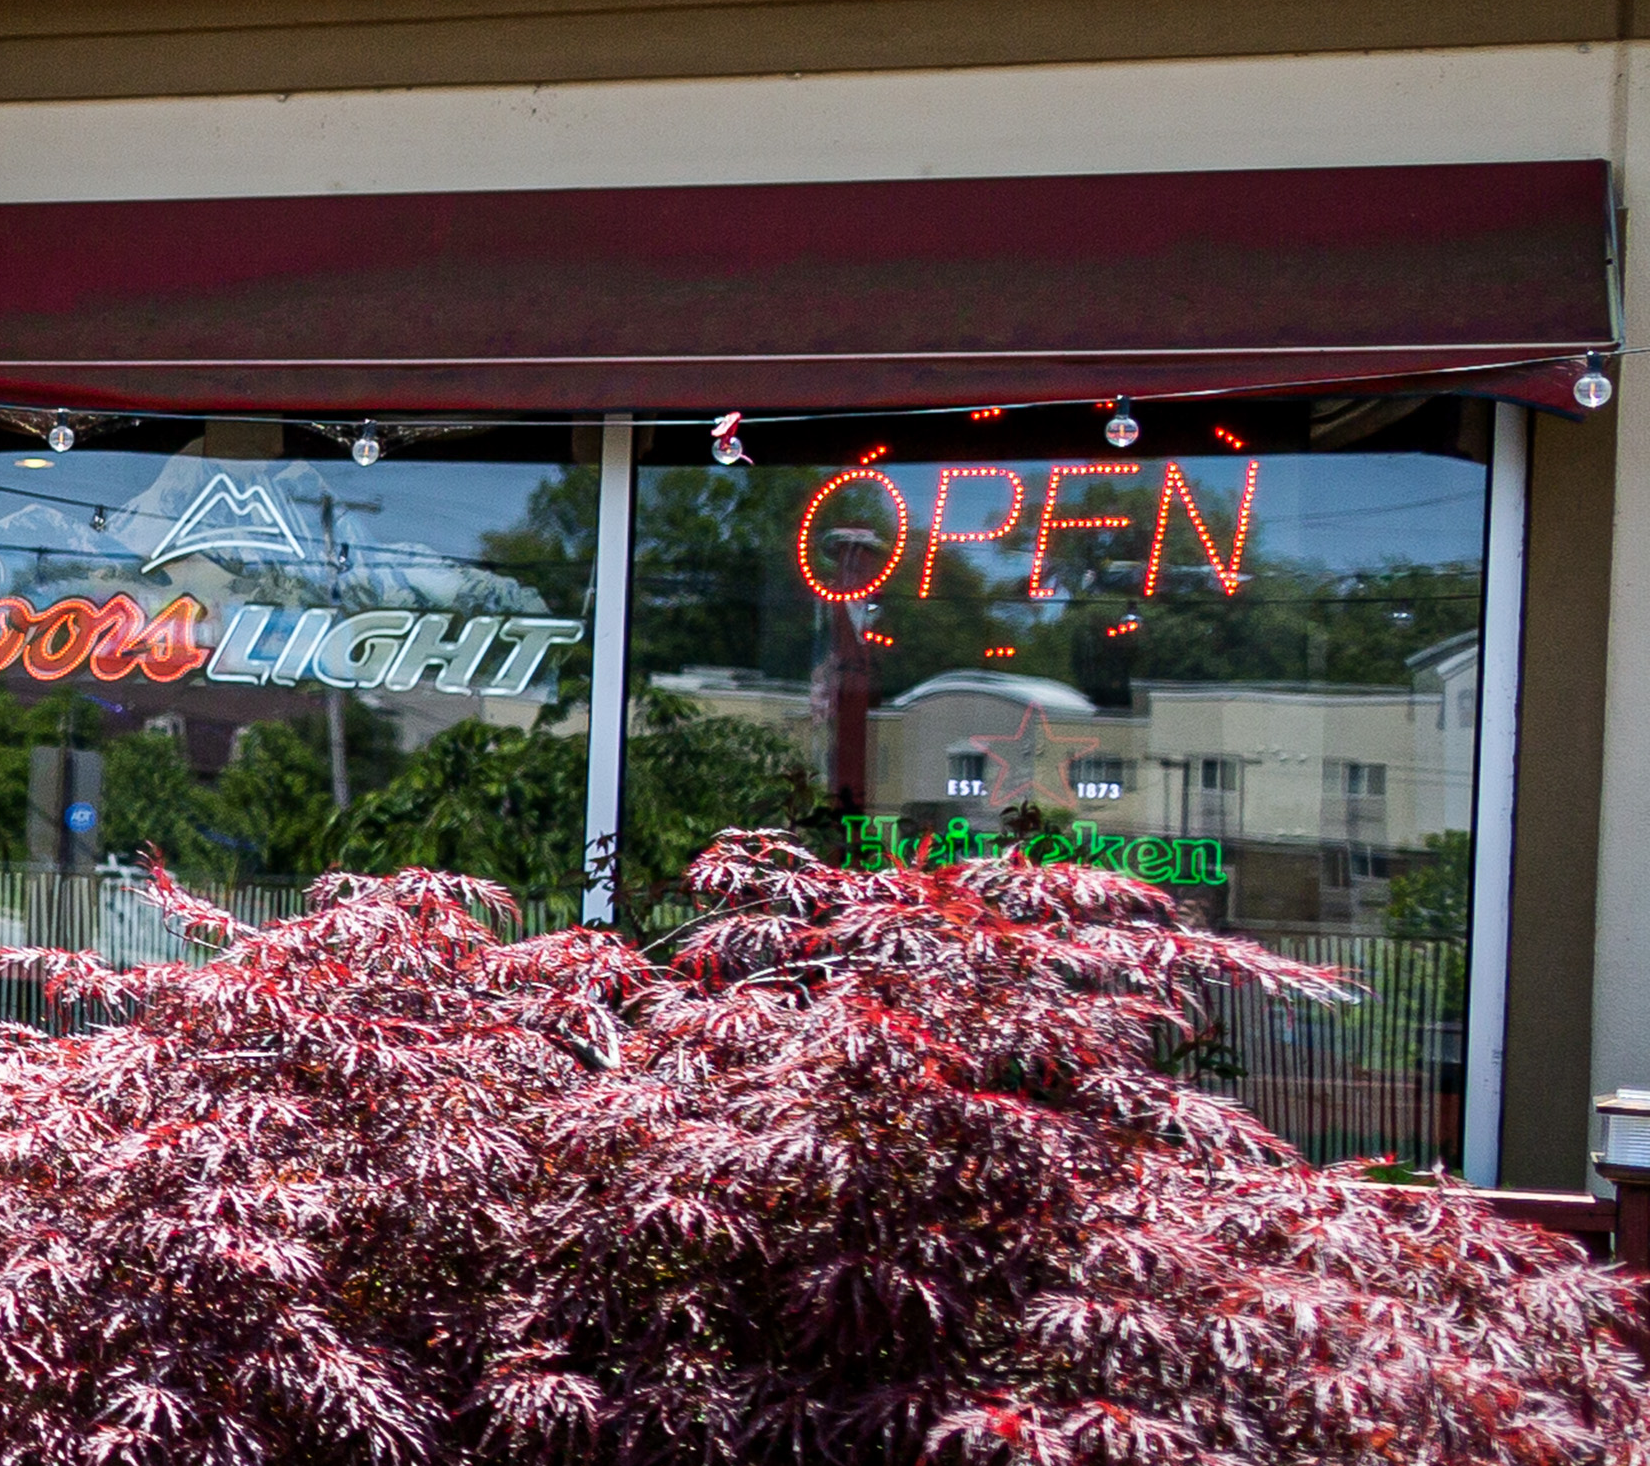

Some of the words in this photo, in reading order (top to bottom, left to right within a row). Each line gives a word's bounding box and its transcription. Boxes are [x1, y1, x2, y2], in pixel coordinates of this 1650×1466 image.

[797, 461, 1260, 602] OPEN
[205, 604, 586, 698] LIGHT
[947, 779, 988, 797] EST.
[1077, 782, 1122, 800] 1873
